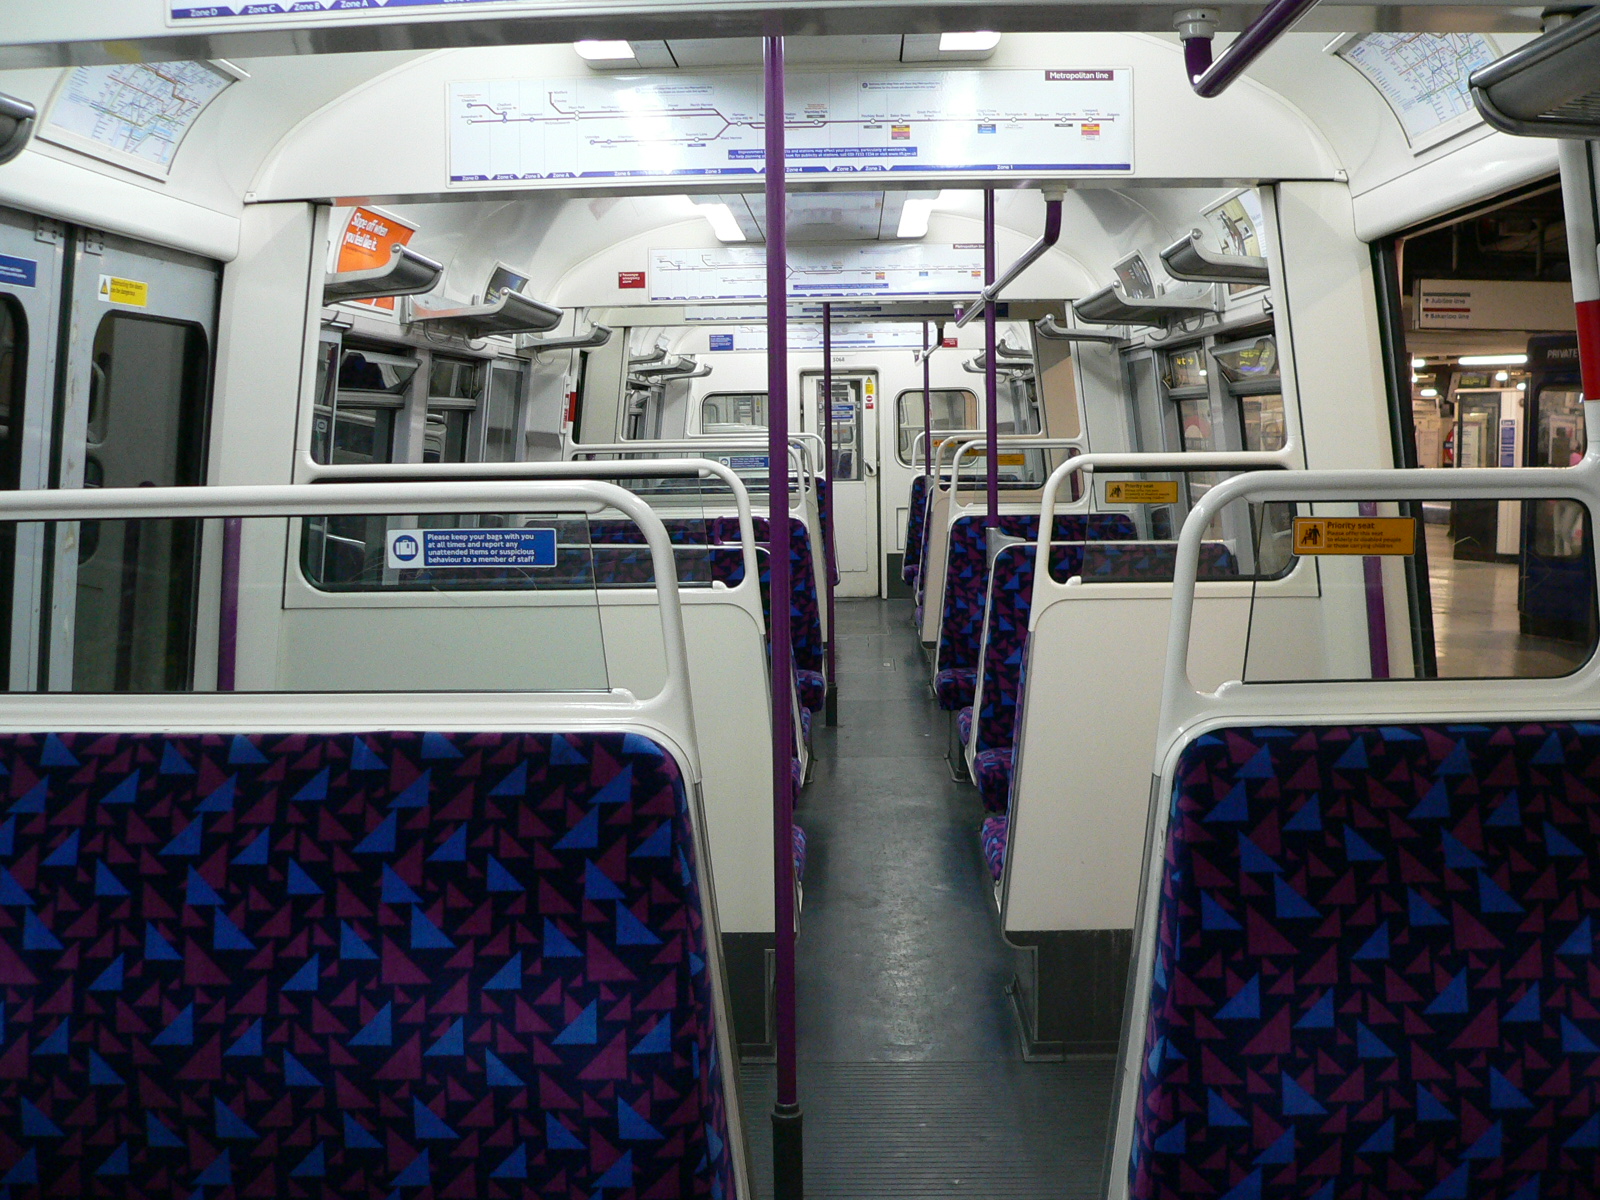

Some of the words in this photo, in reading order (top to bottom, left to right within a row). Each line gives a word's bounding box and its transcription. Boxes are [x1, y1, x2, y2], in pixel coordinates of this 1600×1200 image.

[340, 1, 359, 9] Zone
[190, 8, 208, 16] Zone
[1050, 71, 1094, 80] Metropolitan
[1095, 71, 1109, 79] line
[1547, 348, 1578, 358] PRIVATE
[1327, 521, 1356, 530] Priority
[451, 533, 468, 541] keep
[487, 533, 503, 541] bags
[482, 541, 505, 549] report
[500, 548, 535, 556] suspicious
